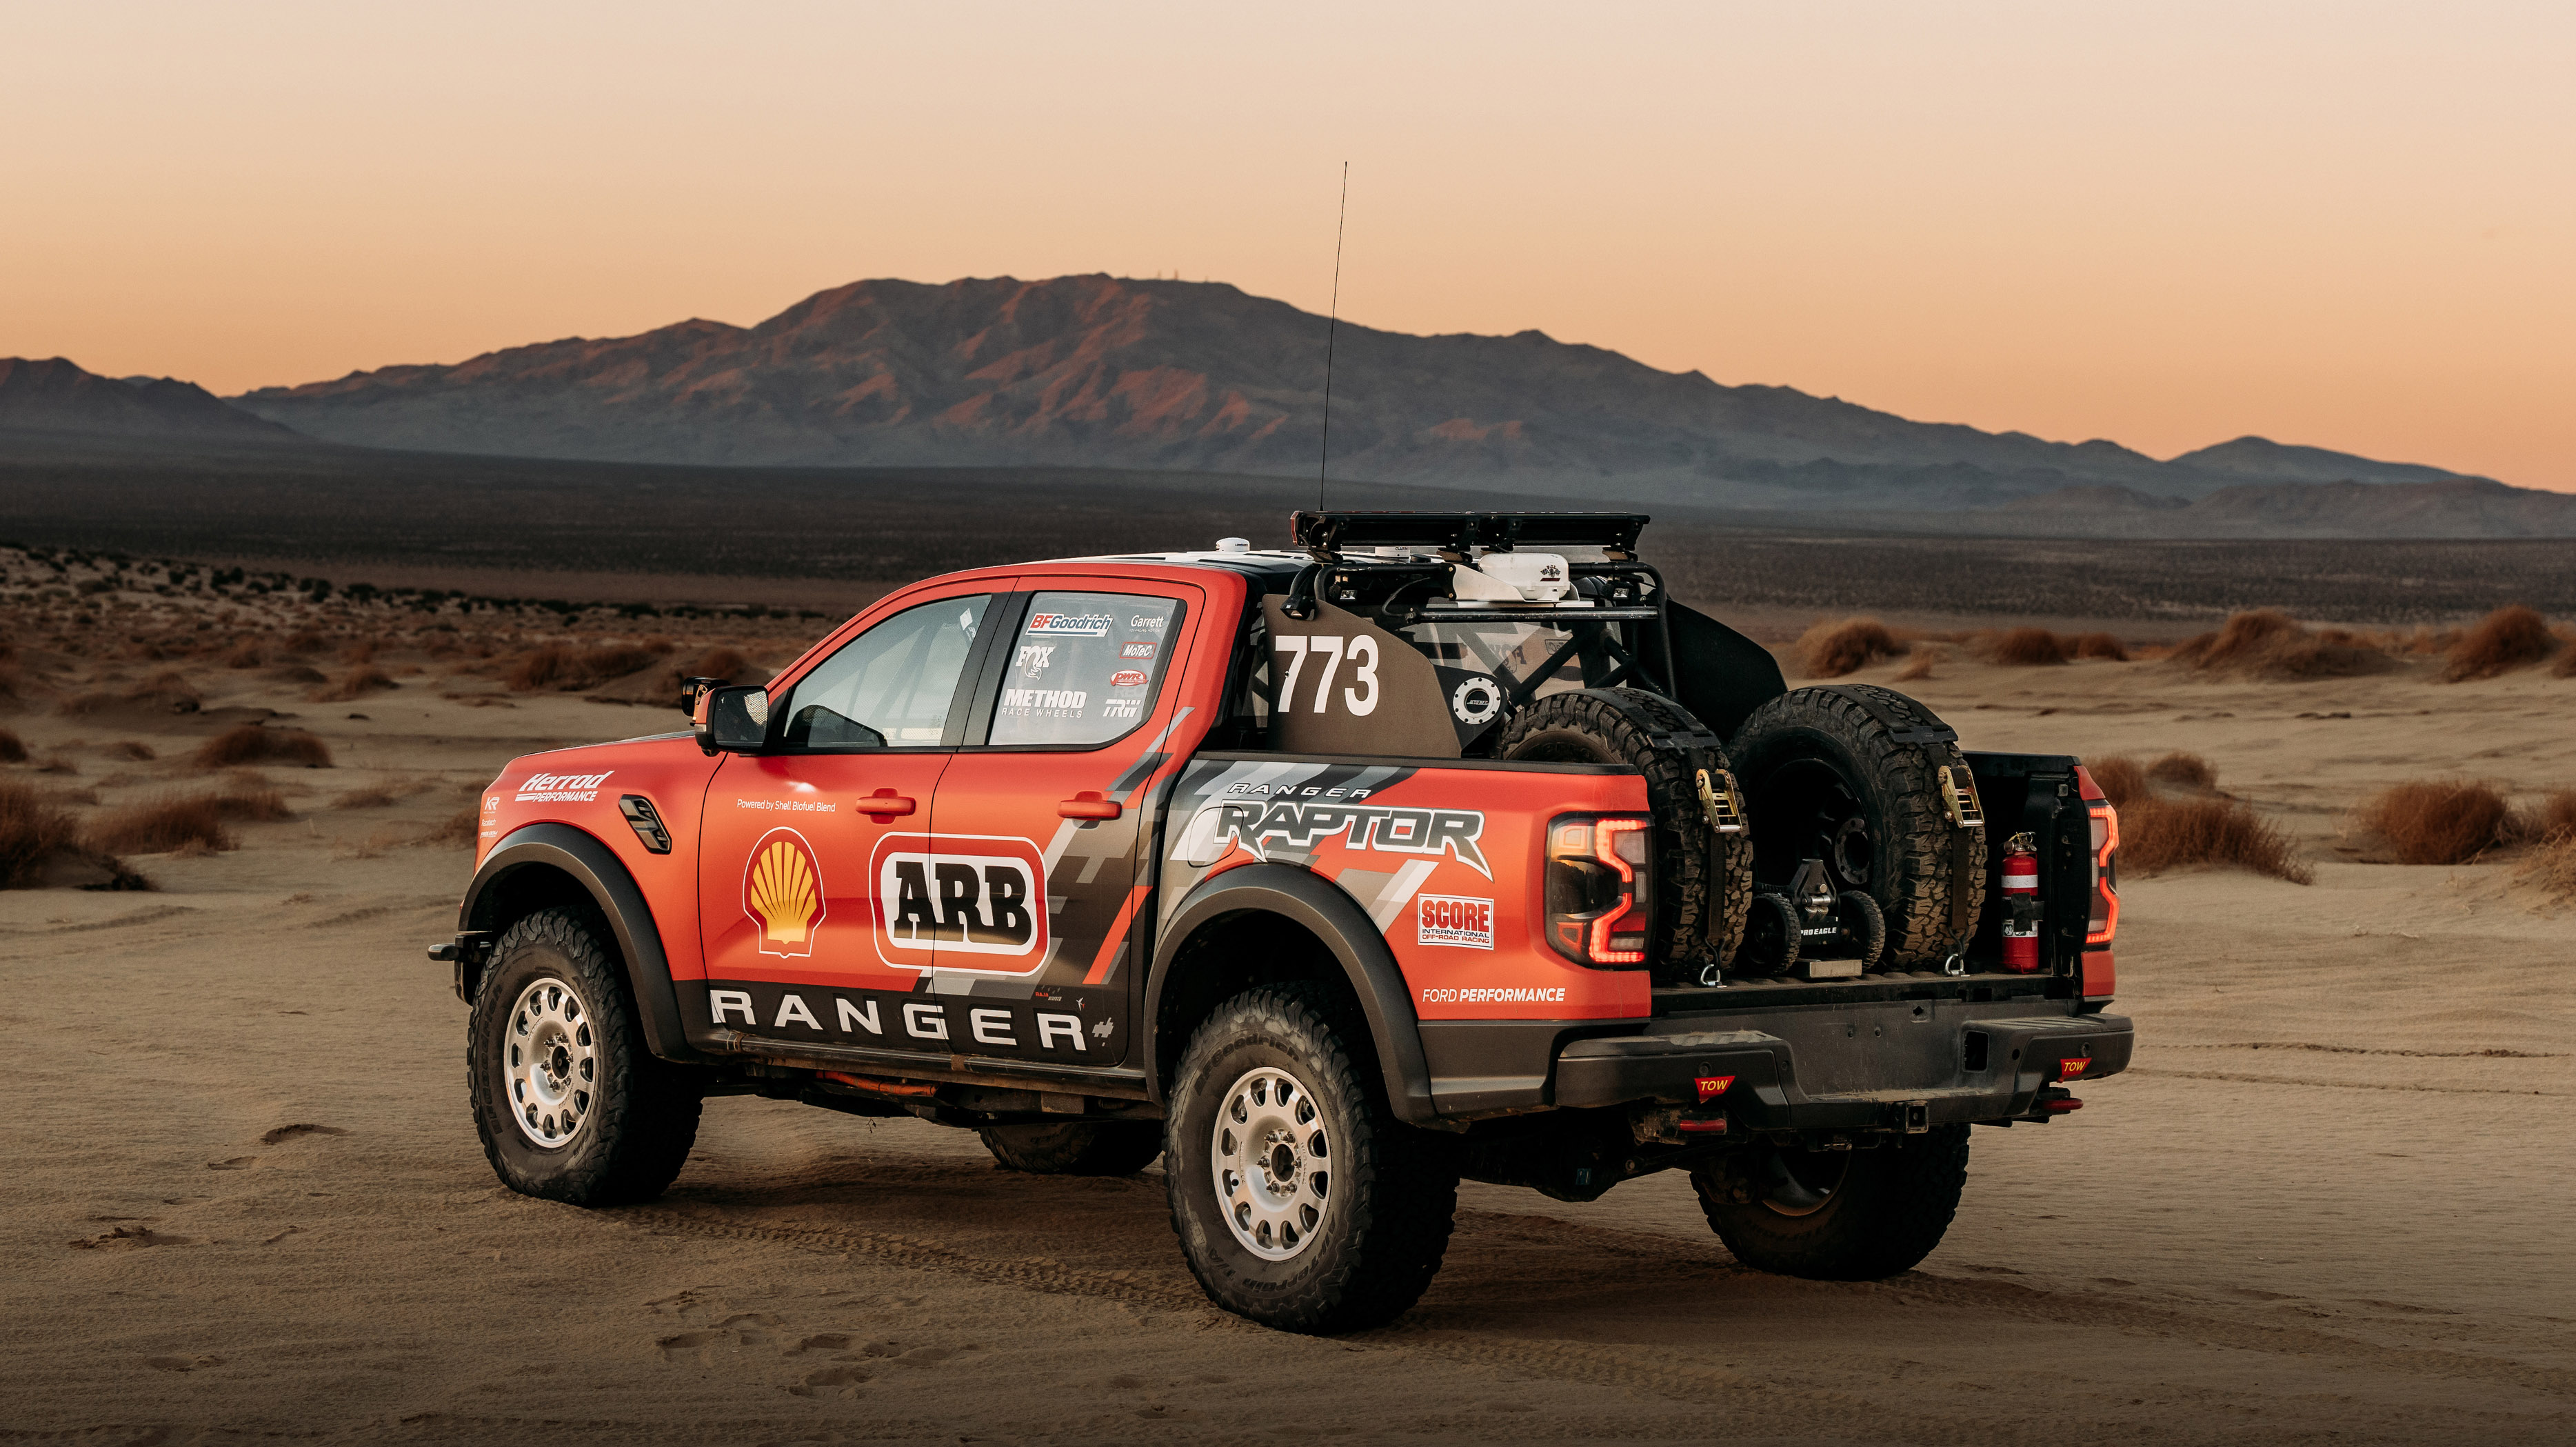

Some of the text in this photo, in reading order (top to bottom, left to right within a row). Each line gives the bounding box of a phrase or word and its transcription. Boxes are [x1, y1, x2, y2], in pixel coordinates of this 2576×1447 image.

[1030, 615, 1111, 629] BFGoodrich
[1131, 615, 1164, 628] Garrett
[1123, 644, 1153, 657] MoTeC
[1015, 645, 1055, 675] FOX
[1275, 635, 1379, 717] 773
[1003, 688, 1087, 709] METHOD
[1002, 708, 1083, 719] RACE WHEELS
[1103, 699, 1142, 718] TRW
[519, 770, 615, 791] Herrod
[533, 791, 598, 802] PERFORMANCE
[1227, 783, 1371, 799] RANGER
[737, 799, 836, 812] Powered by Shell Biofuel Blend
[1213, 799, 1494, 882] RAPTOR
[894, 861, 1032, 946] ARB
[1422, 900, 1489, 932] SCORE
[1422, 928, 1489, 938] INTERNATIONAL
[1422, 988, 1565, 1002] FORD PERFORMANCE
[710, 989, 1087, 1052] RANGER
[2062, 1061, 2086, 1072] TOW
[1700, 1078, 1728, 1091] TOW
